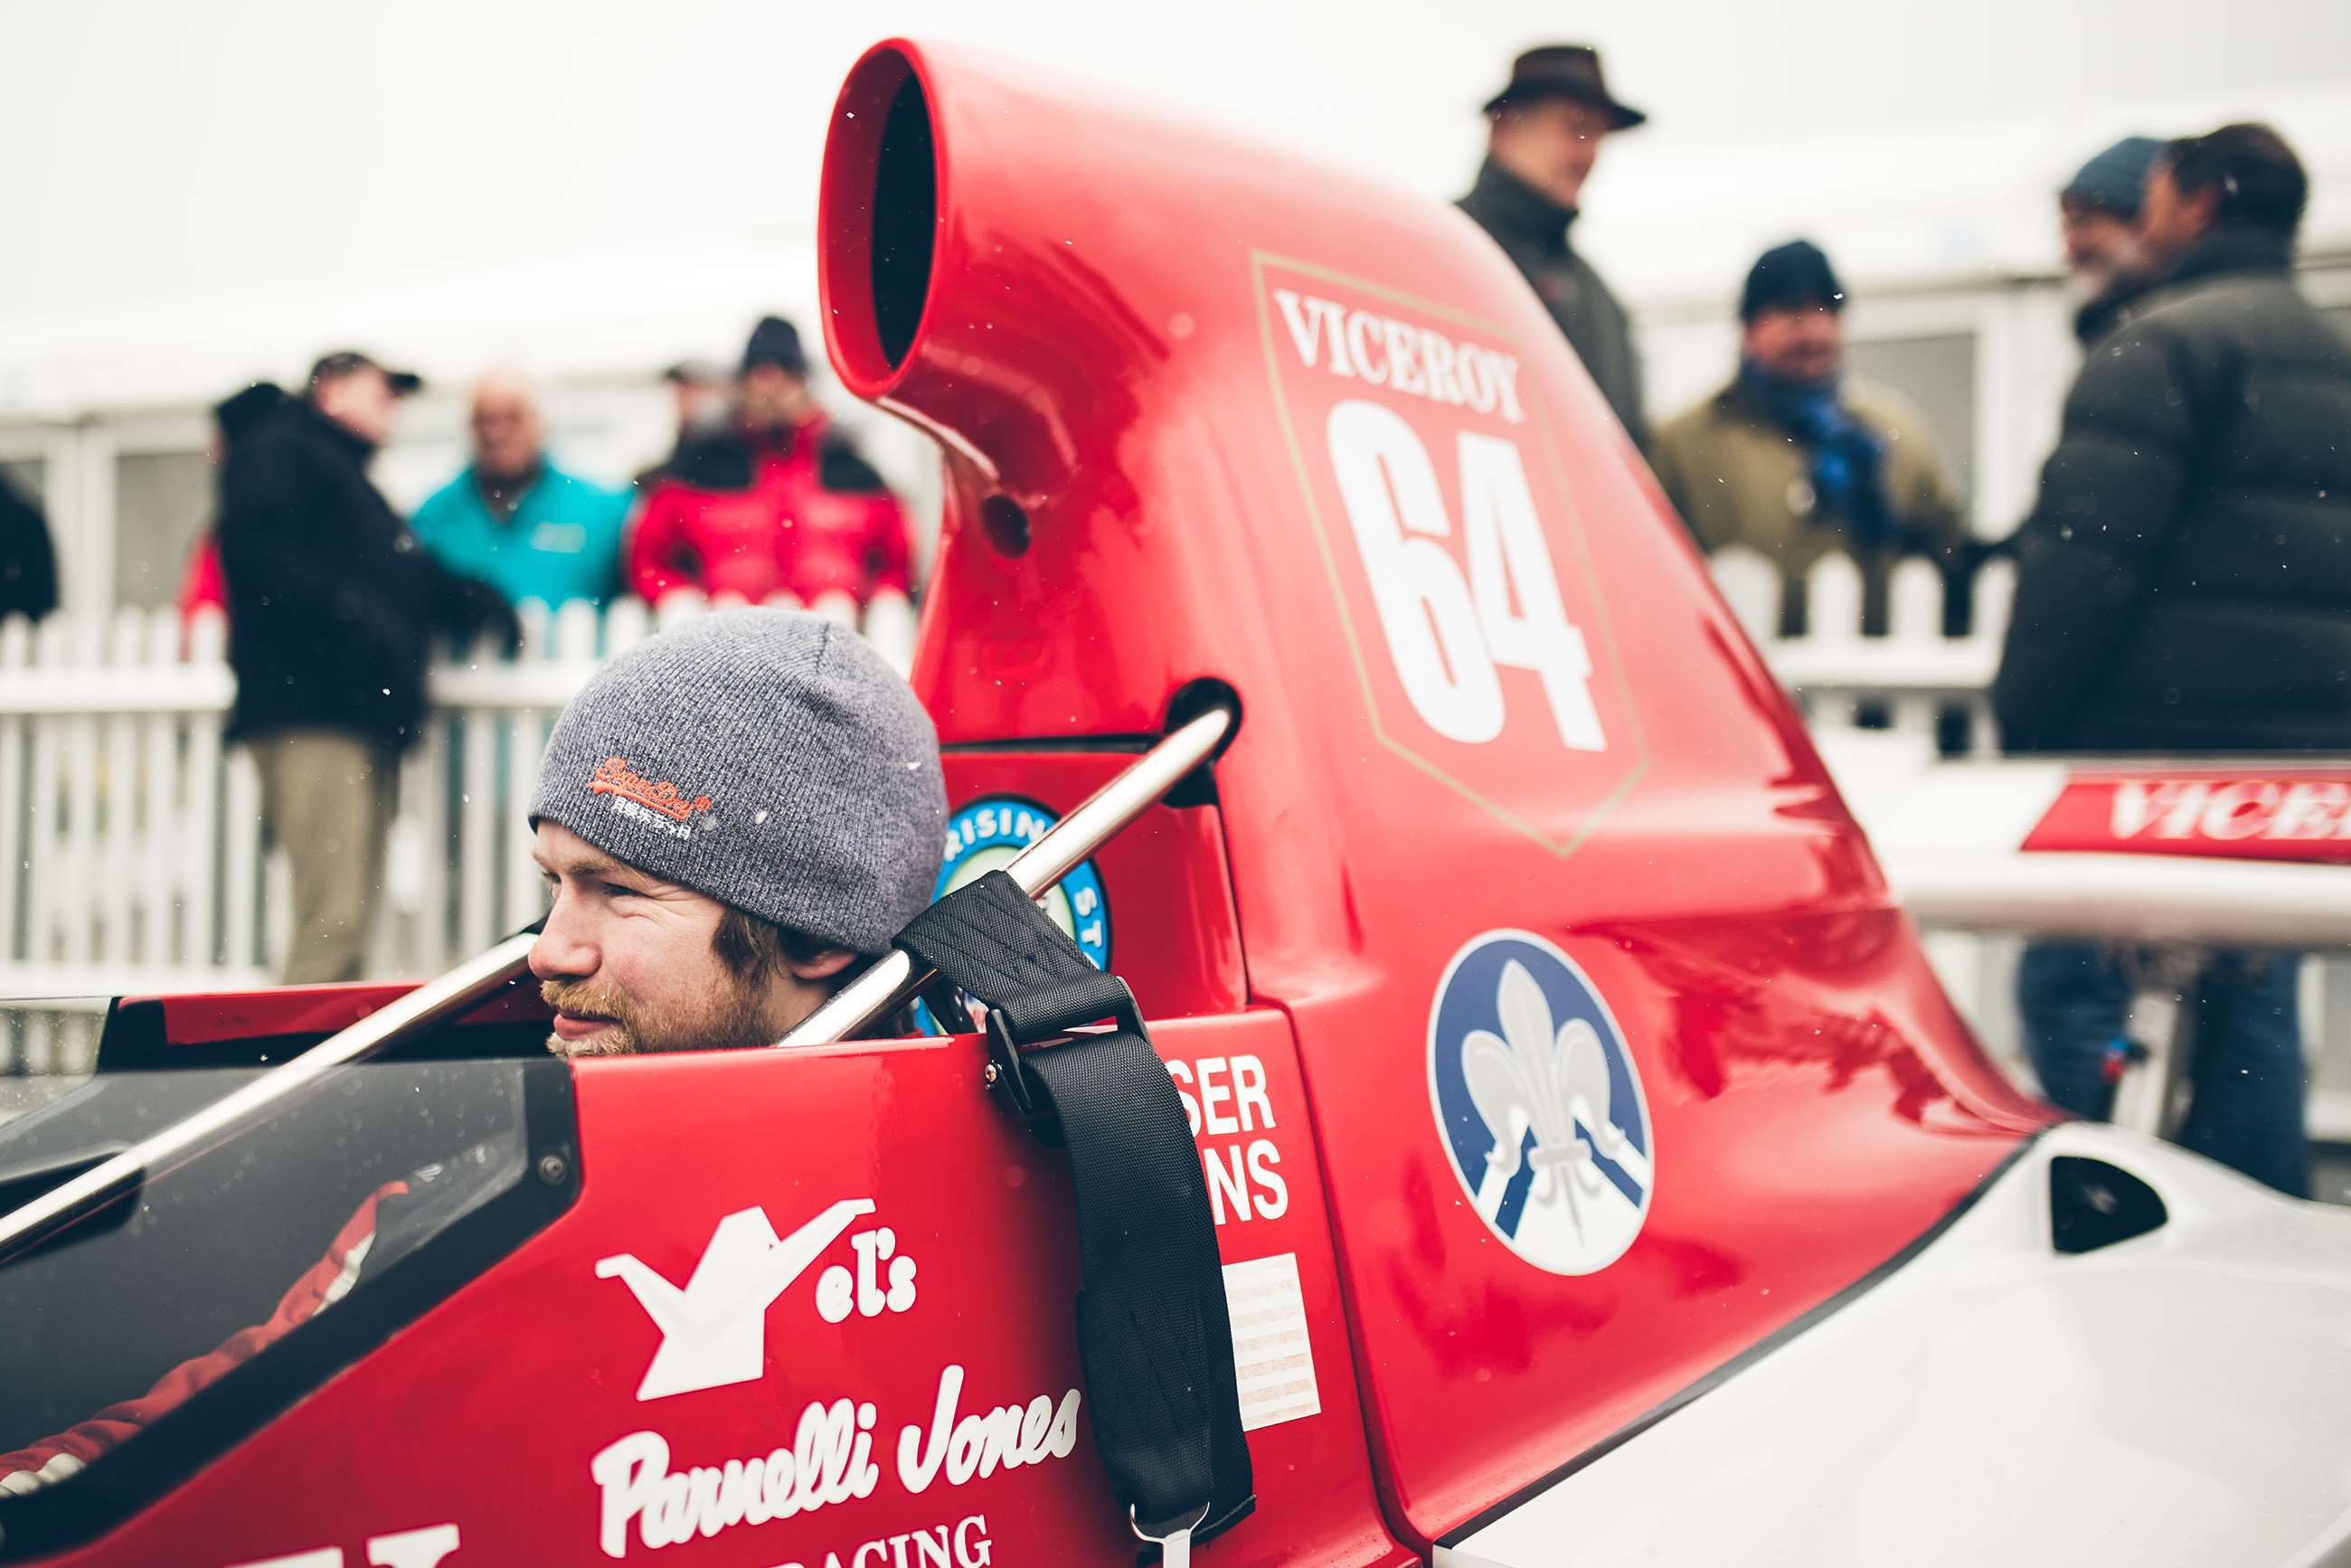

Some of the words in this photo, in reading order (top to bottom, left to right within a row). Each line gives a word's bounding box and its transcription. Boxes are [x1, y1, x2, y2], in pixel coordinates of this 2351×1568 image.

[1273, 288, 1524, 424] VICEROY
[1327, 398, 1607, 752] 64
[2110, 779, 2351, 840] VICE
[590, 1397, 880, 1559] Parnelli
[897, 1364, 1081, 1494] Jones
[768, 1513, 993, 1568] CING
